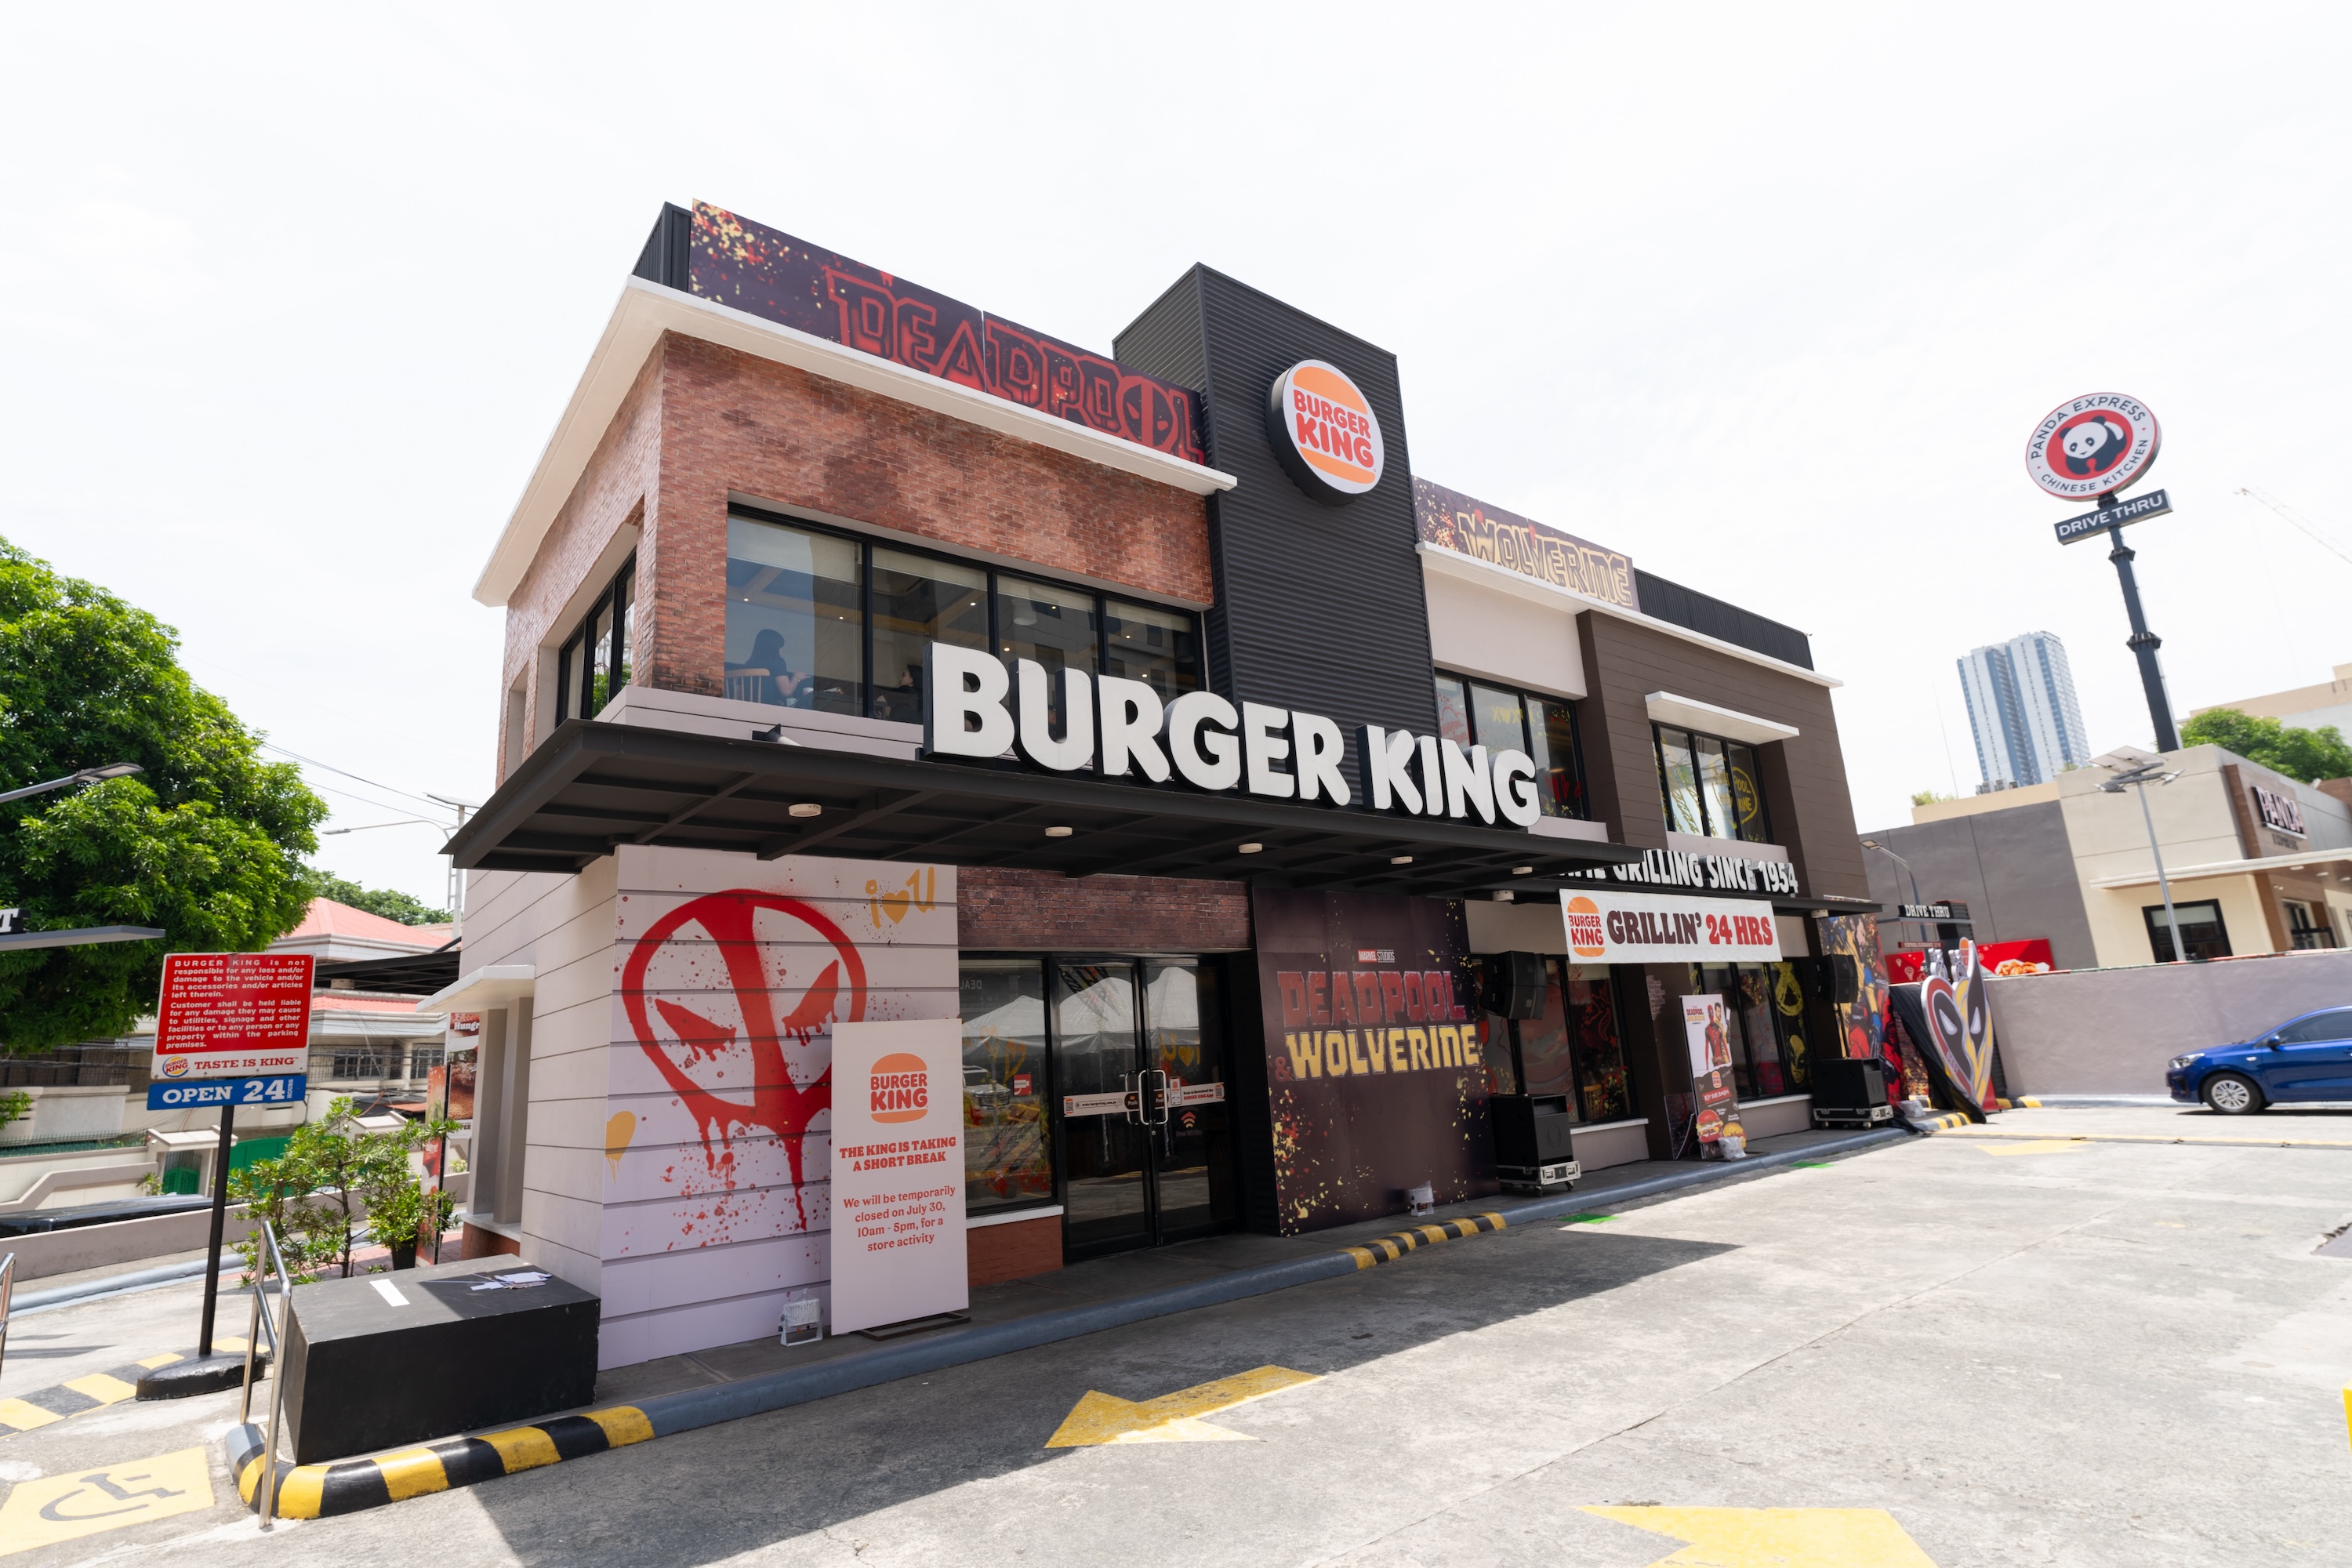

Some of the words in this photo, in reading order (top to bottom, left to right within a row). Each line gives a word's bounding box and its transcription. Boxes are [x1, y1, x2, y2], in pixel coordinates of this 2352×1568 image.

[1294, 390, 1370, 439] BURGER
[1296, 413, 1374, 467] KING
[2031, 412, 2068, 459] PANDA
[2073, 397, 2146, 421] EXPRESS
[2042, 474, 2096, 492] CHINESE
[2103, 439, 2148, 485] KITCHEN
[2059, 512, 2111, 536] DRIVE
[2112, 495, 2163, 518] THRU
[1457, 508, 1633, 606] WOLVERINE
[931, 641, 1351, 808] BURGER
[1363, 724, 1541, 828] KING
[2253, 786, 2306, 834] PANDA
[1706, 855, 1757, 891] SINCE
[1759, 860, 1798, 894] 1954
[1569, 915, 1601, 927] BURGER
[1904, 905, 1929, 917] DRIVE
[1929, 906, 1950, 918] THRU
[1571, 928, 1603, 946] KING
[1607, 910, 1701, 945] GRILLIN'
[1706, 914, 1733, 945] 24
[1733, 916, 1773, 946] HRS
[1358, 950, 1376, 961] MARVEL
[1377, 951, 1395, 962] STUDIOS
[1277, 971, 1466, 1028] DEADPOOL
[166, 1041, 206, 1050] premises.
[1275, 1056, 1293, 1082] &
[1285, 1024, 1479, 1081] WOLVERINE
[165, 1058, 187, 1069] BURGER
[165, 1062, 188, 1074] KING
[194, 1060, 238, 1069] TASTE
[162, 1086, 233, 1104] OPEN
[243, 1080, 285, 1102] 24
[871, 1073, 927, 1090] BURGER
[871, 1088, 927, 1112] KING
[840, 1147, 864, 1159] THE
[866, 1143, 897, 1156] KING
[898, 1142, 909, 1152] IS
[912, 1137, 956, 1151] TAKING
[853, 1161, 862, 1171] A
[864, 1156, 905, 1171] SHORT
[907, 1152, 946, 1166] BREAK
[844, 1198, 859, 1209] We
[862, 1194, 880, 1206] will
[884, 1192, 895, 1203] be
[898, 1185, 956, 1203] temporarily
[855, 1209, 889, 1223] closed
[891, 1209, 904, 1218] on
[906, 1203, 927, 1217] July
[930, 1201, 946, 1213] 30,
[858, 1226, 884, 1238] 10am
[894, 1221, 918, 1234] 5pm,
[921, 1218, 935, 1229] for
[867, 1240, 895, 1251] store
[897, 1232, 935, 1247] activity
